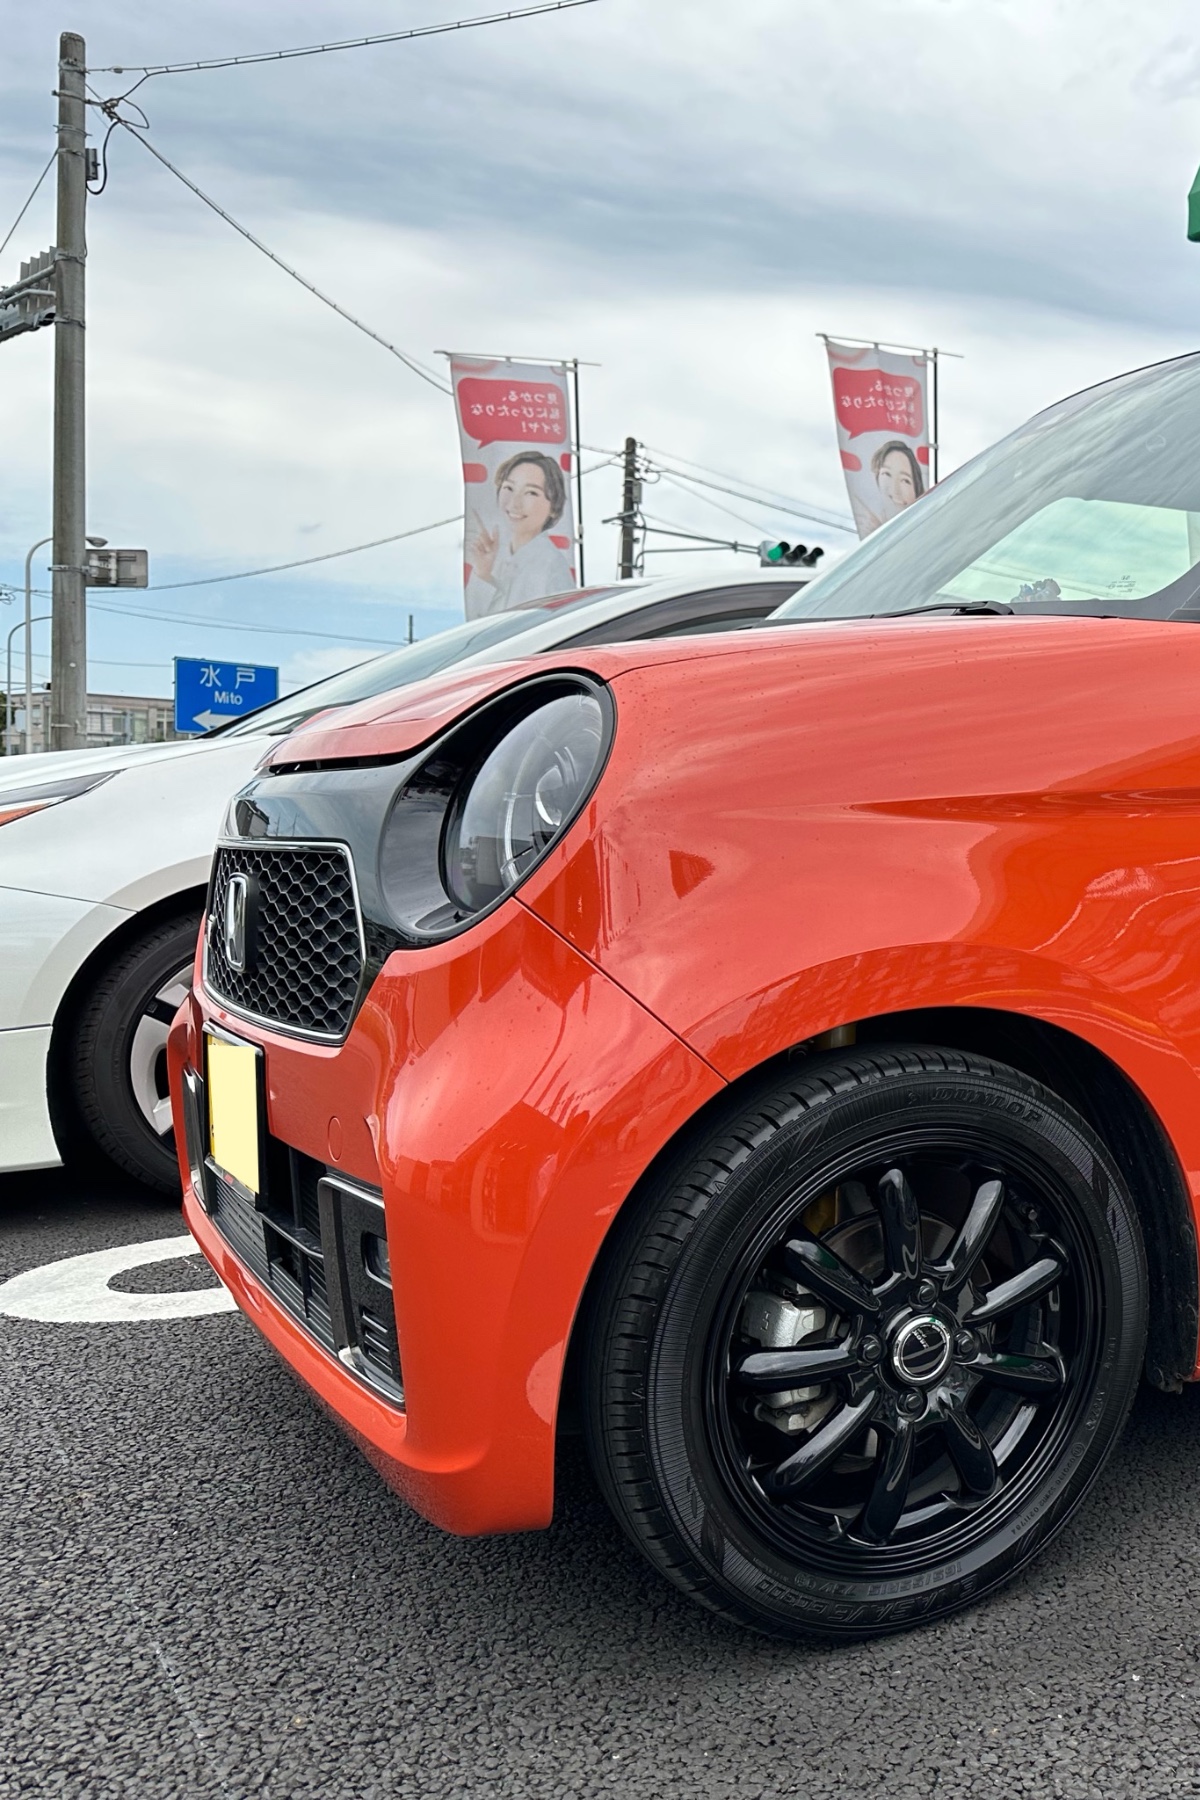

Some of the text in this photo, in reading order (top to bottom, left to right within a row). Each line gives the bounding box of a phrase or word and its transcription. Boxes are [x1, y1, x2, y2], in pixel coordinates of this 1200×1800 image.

[200, 664, 256, 689] 水戸
[214, 691, 243, 705] Mito
[931, 1086, 1044, 1121] DUNLOP
